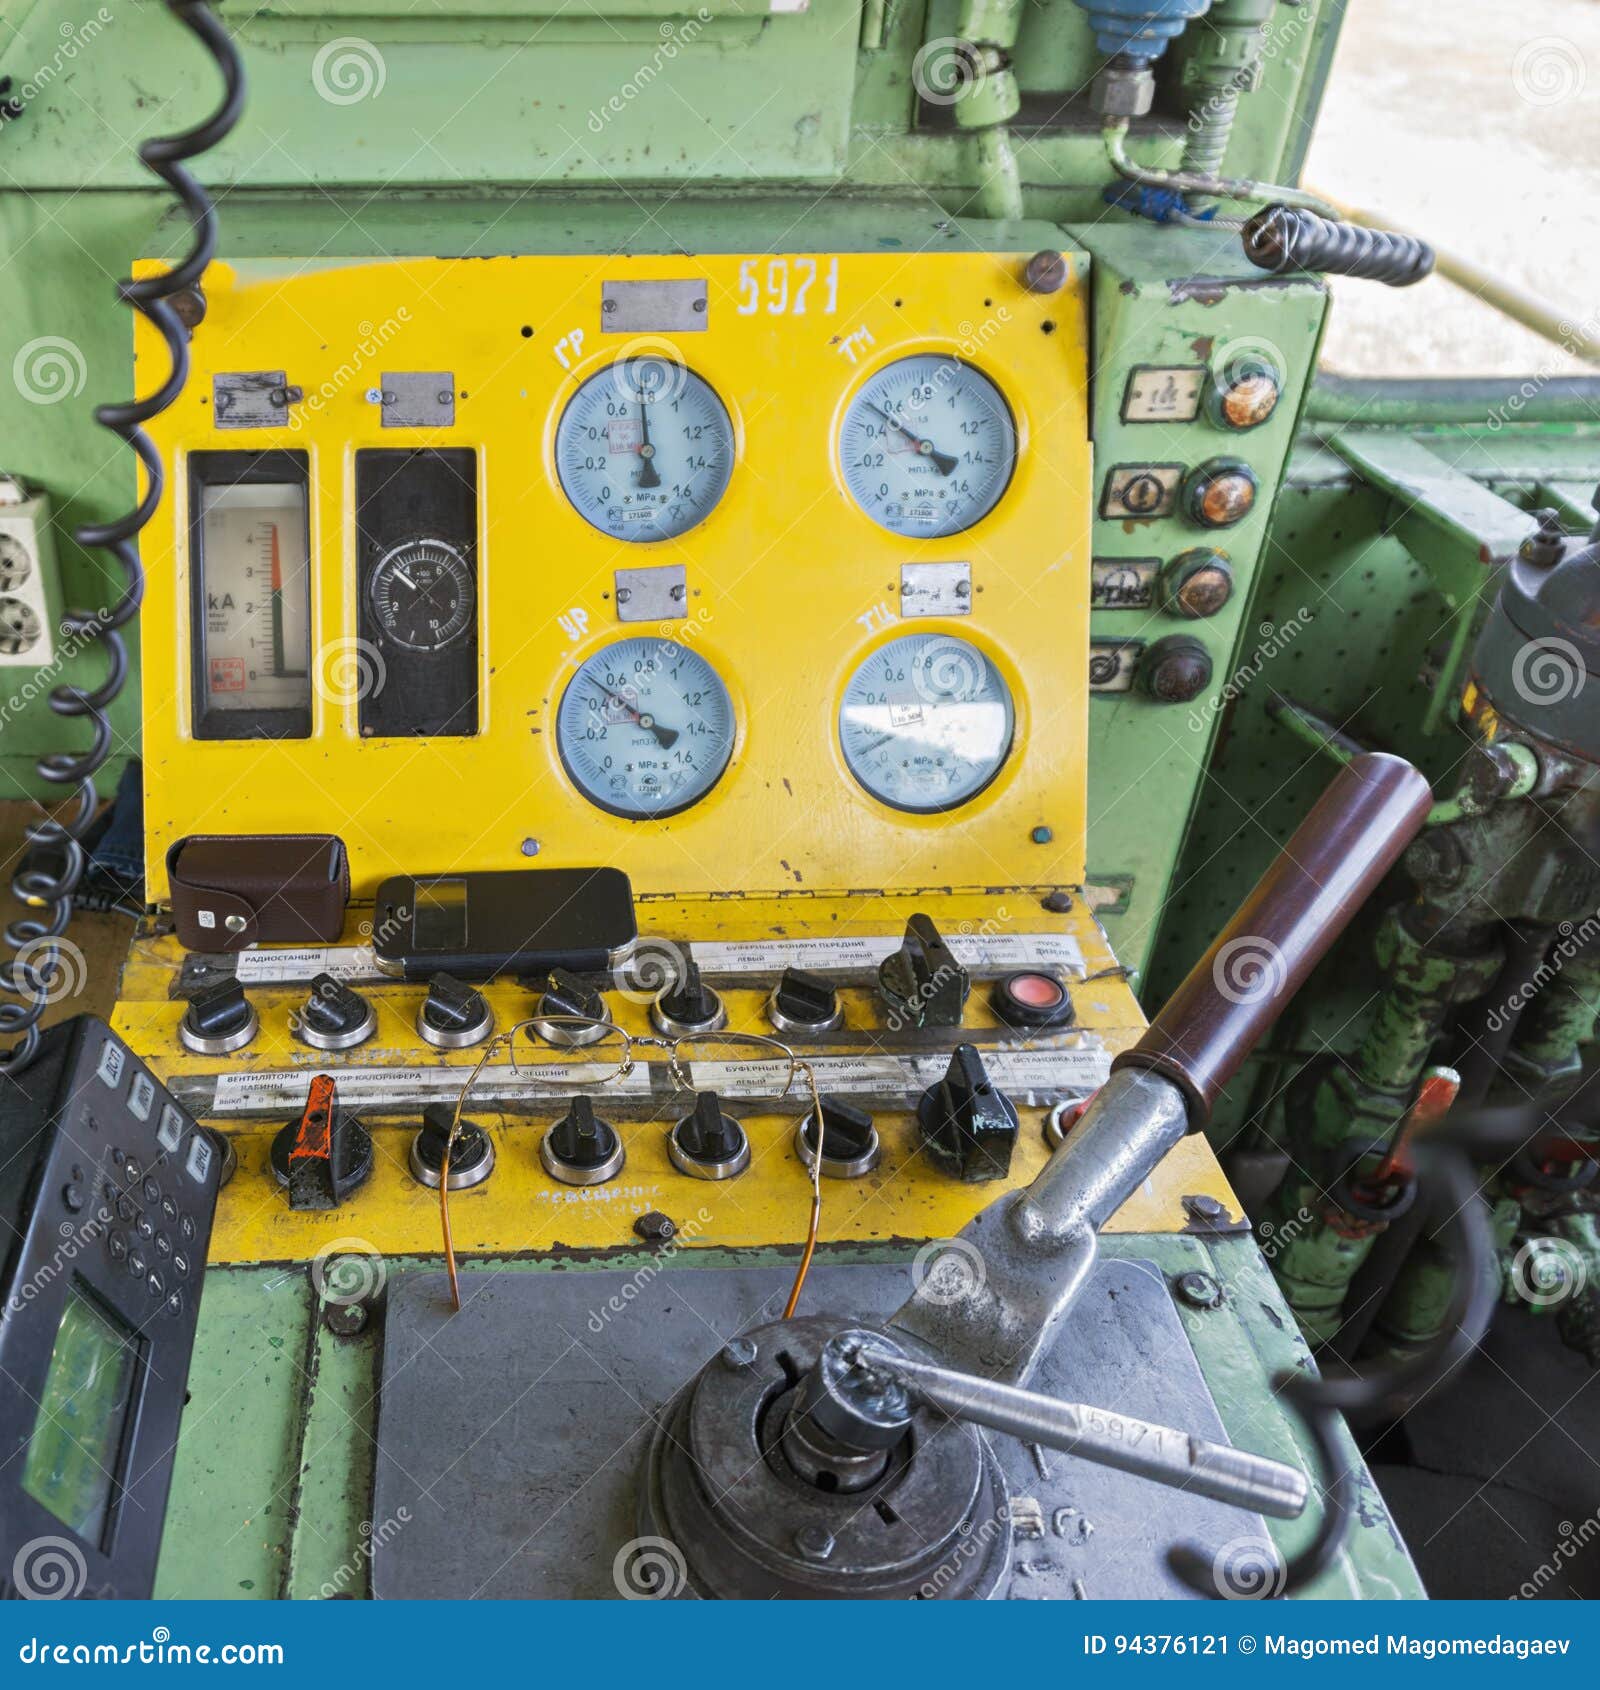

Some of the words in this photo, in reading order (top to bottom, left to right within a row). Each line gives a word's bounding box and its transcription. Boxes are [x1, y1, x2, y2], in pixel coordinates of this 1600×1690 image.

[737, 257, 838, 316] 5971
[911, 387, 932, 401] 0,8
[606, 402, 627, 416] 0,6
[672, 400, 679, 413] 1
[947, 396, 955, 408] 1
[588, 428, 609, 442] 0,4
[683, 426, 702, 441] 1,2
[866, 424, 887, 439] 0,4
[960, 421, 979, 436] 1,2
[585, 457, 606, 471] 0,2
[686, 456, 705, 471] 1,4
[863, 454, 884, 469] 0,2
[963, 450, 982, 465] 1,4
[601, 486, 611, 499] 0
[672, 484, 692, 499] 1,6
[879, 482, 888, 496] 0
[914, 488, 934, 497] MPa
[950, 479, 969, 494] 1,6
[636, 492, 656, 502] MPa
[245, 566, 253, 578] 3
[403, 565, 410, 575] 4
[436, 565, 443, 575] 6
[208, 592, 235, 610] kA
[245, 602, 253, 614] 2
[392, 601, 399, 611] 2
[450, 599, 456, 608] 8
[429, 619, 439, 629] 10
[634, 660, 655, 674] 0,8
[670, 667, 678, 680] 1
[606, 672, 626, 686] 0,6
[885, 668, 905, 683] 0,6
[682, 692, 702, 706] 1,2
[866, 692, 887, 705] 0,4
[586, 727, 607, 742] 0,2
[686, 721, 705, 736] 1,4
[604, 755, 612, 769] 0
[638, 760, 658, 769] MPa
[674, 750, 693, 765] 1,6
[914, 756, 933, 765] MPa
[726, 944, 775, 952] БУФЕРНЫЕ
[819, 940, 866, 949] ПЕРЕДНИЕ
[244, 953, 322, 964] РАДИОСТАНЦИЯ
[737, 955, 765, 963] ЛЕВЫЙ
[510, 1069, 570, 1078] ОВЕЩЕНИЕ
[725, 1064, 780, 1073] БУФЕРНЫЕ
[828, 1060, 867, 1069] ЗАДНИЕ
[227, 1073, 299, 1083] ВЕНТИЛЯТОРЫ
[355, 1072, 422, 1082] КАЛОРИФЕРА
[736, 1078, 766, 1086] ЛЕВЫЙ
[241, 1083, 283, 1091] КАБИНЫ
[175, 1256, 186, 1271] 0
[150, 1274, 162, 1291] 7
[1088, 1412, 1163, 1453] 5971
